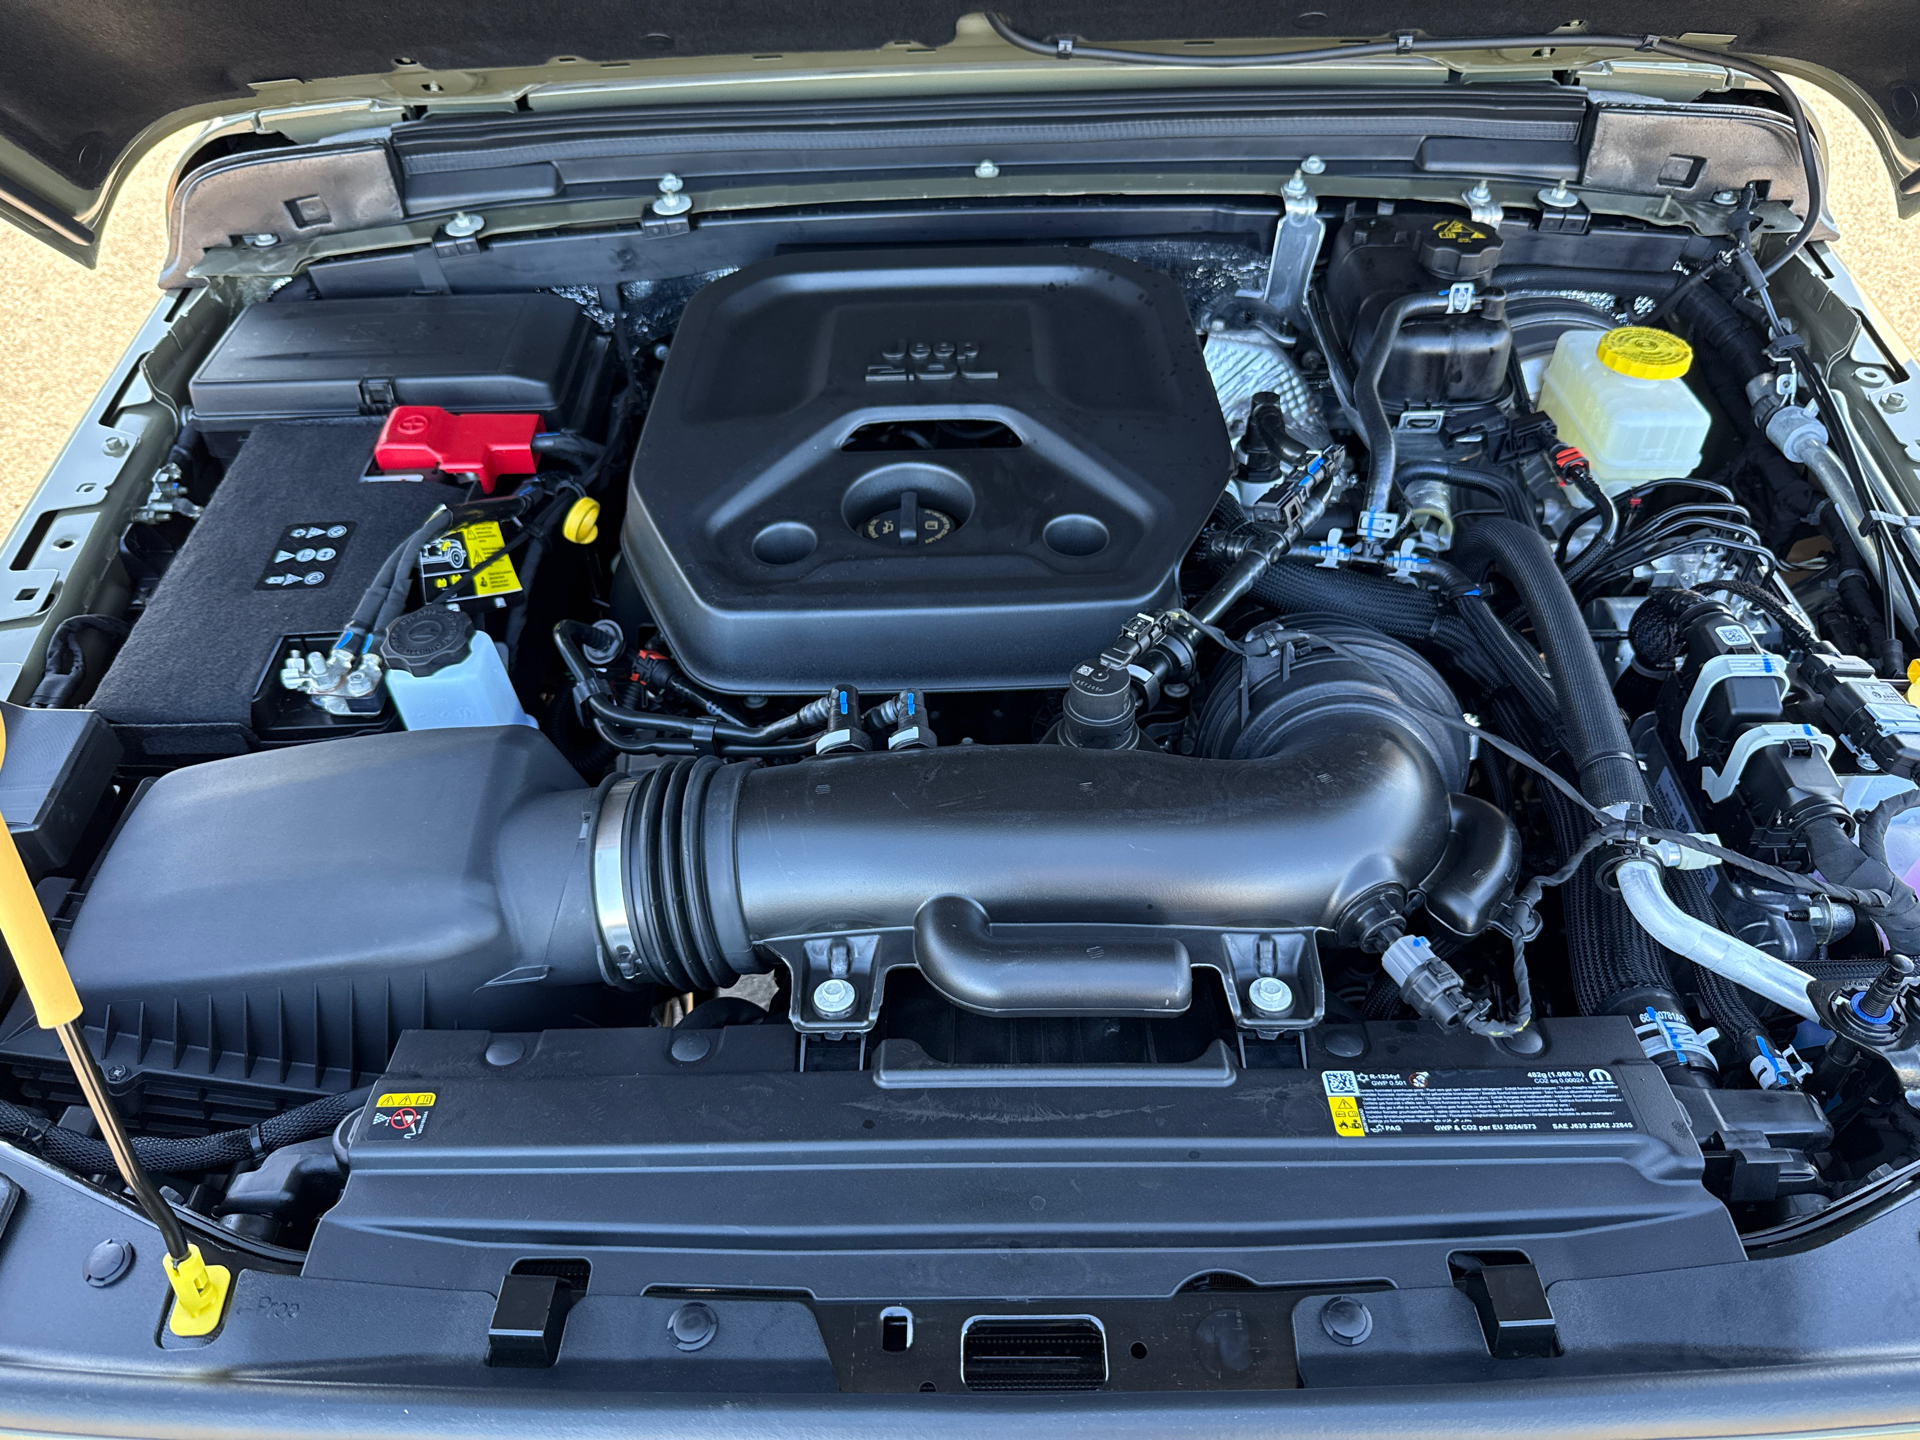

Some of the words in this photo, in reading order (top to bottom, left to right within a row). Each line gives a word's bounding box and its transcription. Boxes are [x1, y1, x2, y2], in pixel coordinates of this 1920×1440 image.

[881, 341, 980, 362] Jeep
[1639, 1010, 1687, 1024] 680781AD
[1504, 1123, 1537, 1131] 2024/573
